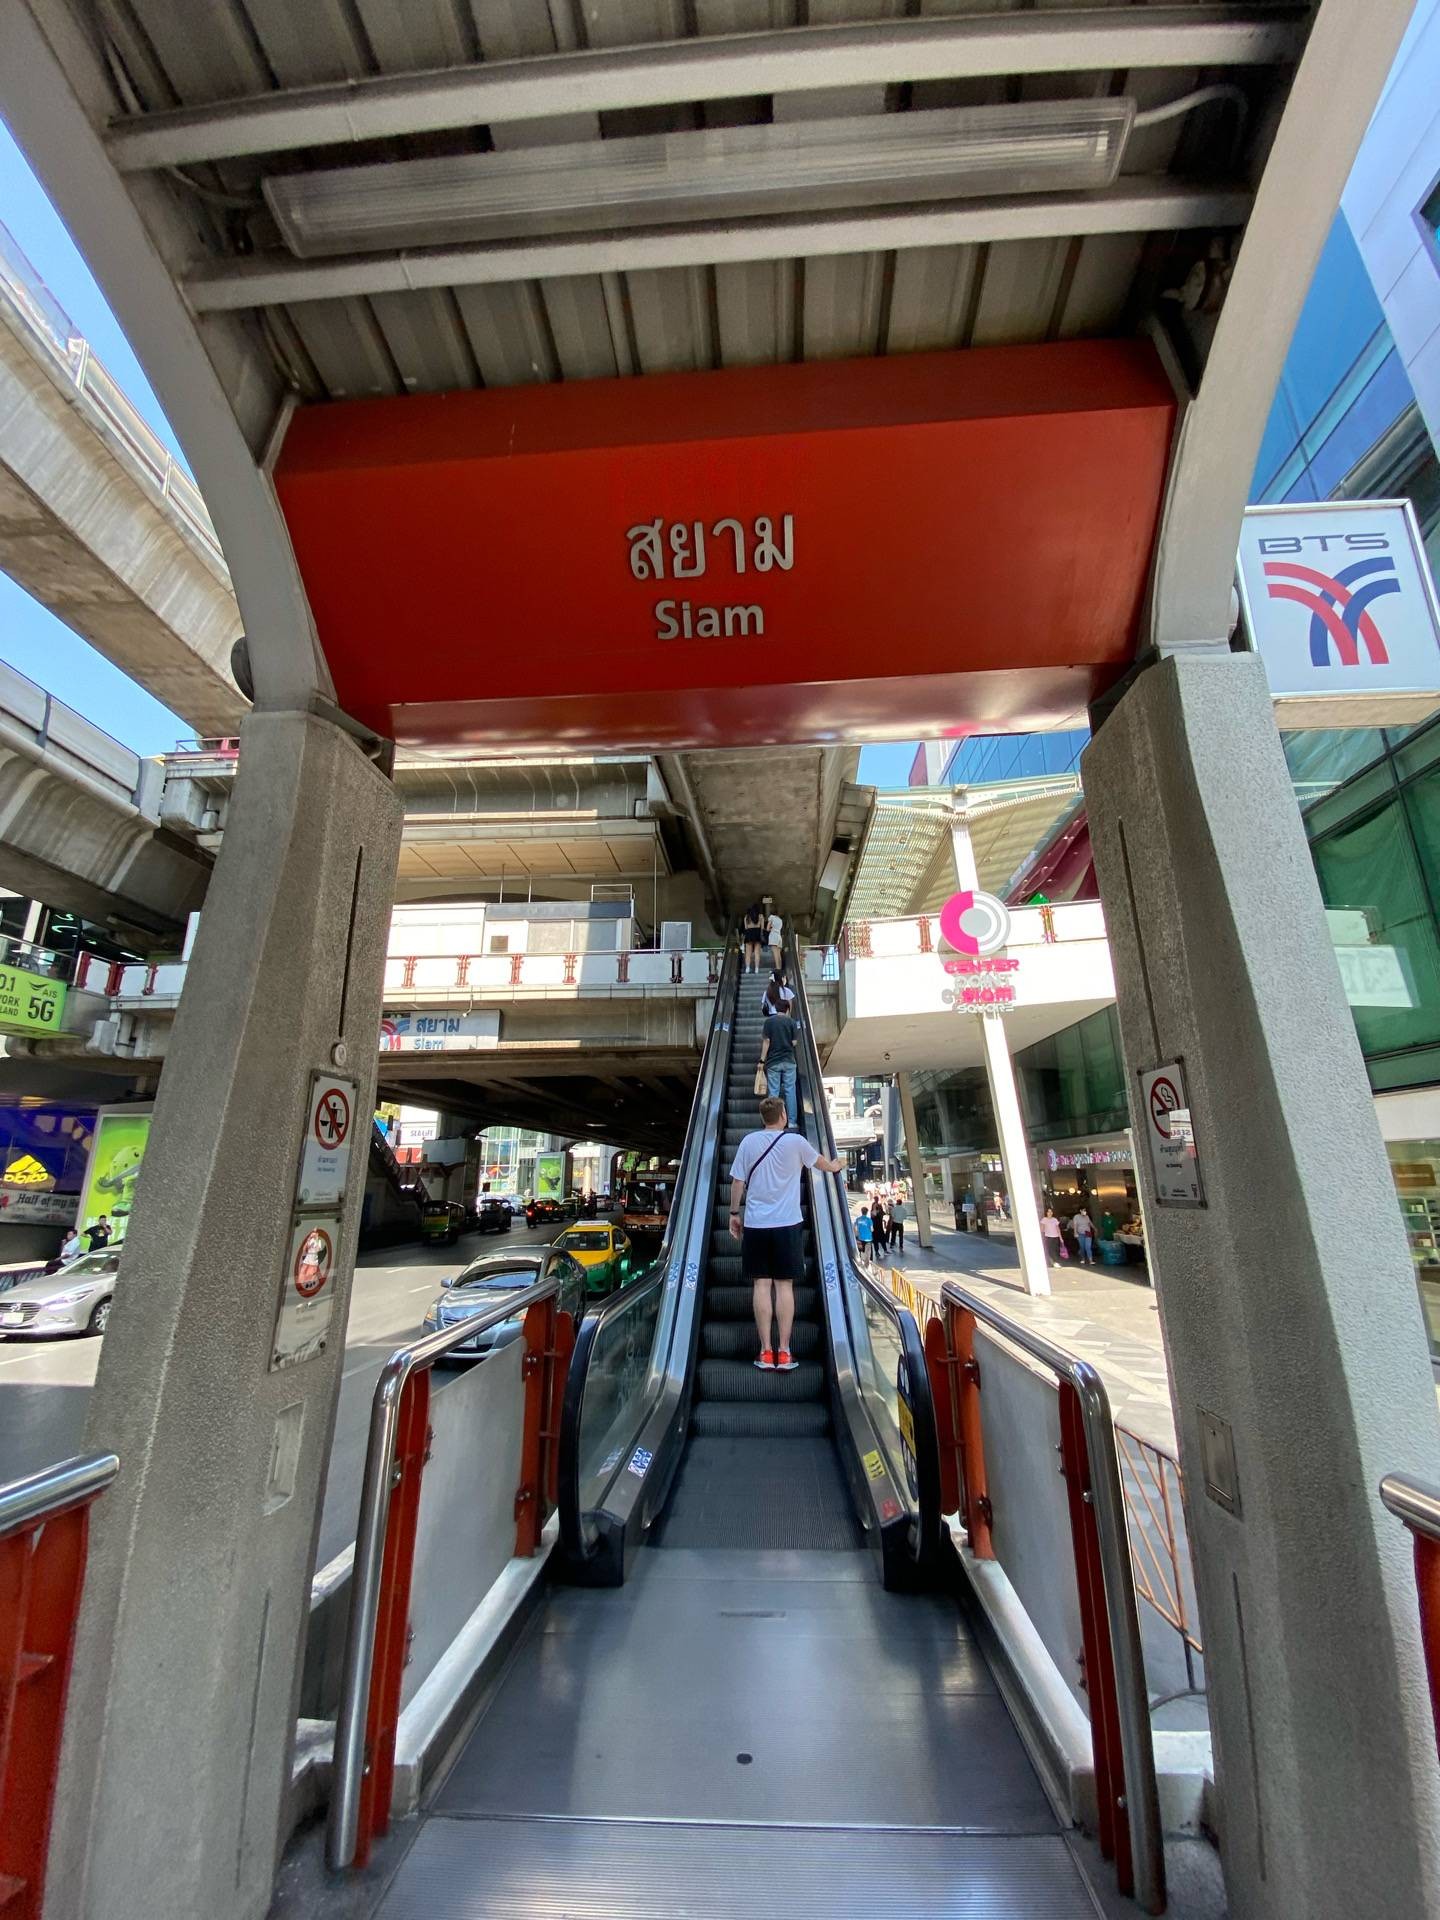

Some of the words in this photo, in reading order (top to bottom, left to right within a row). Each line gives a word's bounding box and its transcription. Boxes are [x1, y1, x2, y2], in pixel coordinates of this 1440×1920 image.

[626, 514, 794, 580] สยาม
[1258, 532, 1389, 555] BTS
[655, 599, 764, 640] Siam
[42, 988, 57, 998] AIS
[28, 996, 55, 1022] 5G
[416, 1017, 460, 1033] สยาม
[414, 1037, 444, 1049] Siam
